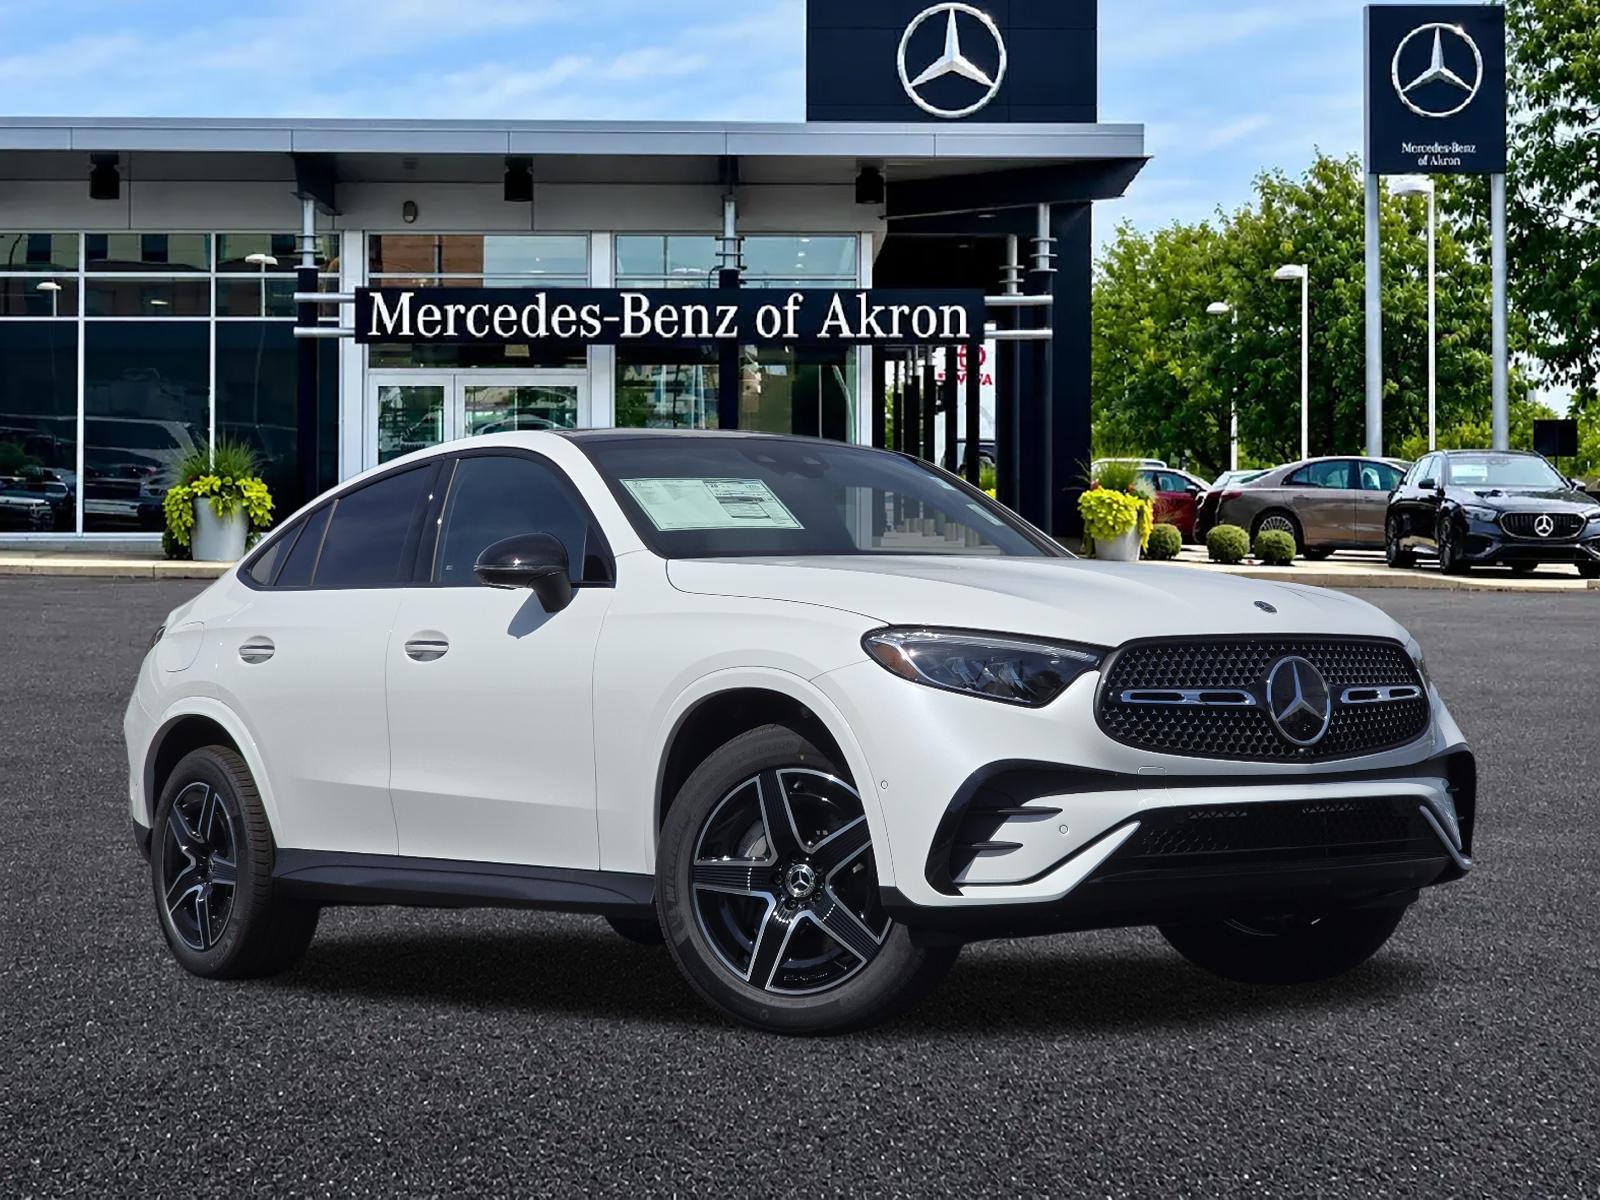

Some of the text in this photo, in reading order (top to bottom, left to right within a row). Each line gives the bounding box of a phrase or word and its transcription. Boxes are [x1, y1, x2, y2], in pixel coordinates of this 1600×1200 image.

[1401, 141, 1476, 153] Mercedes-Benz
[1417, 154, 1461, 166] of Akron
[367, 291, 971, 338] Mercedes-Benz of Akron
